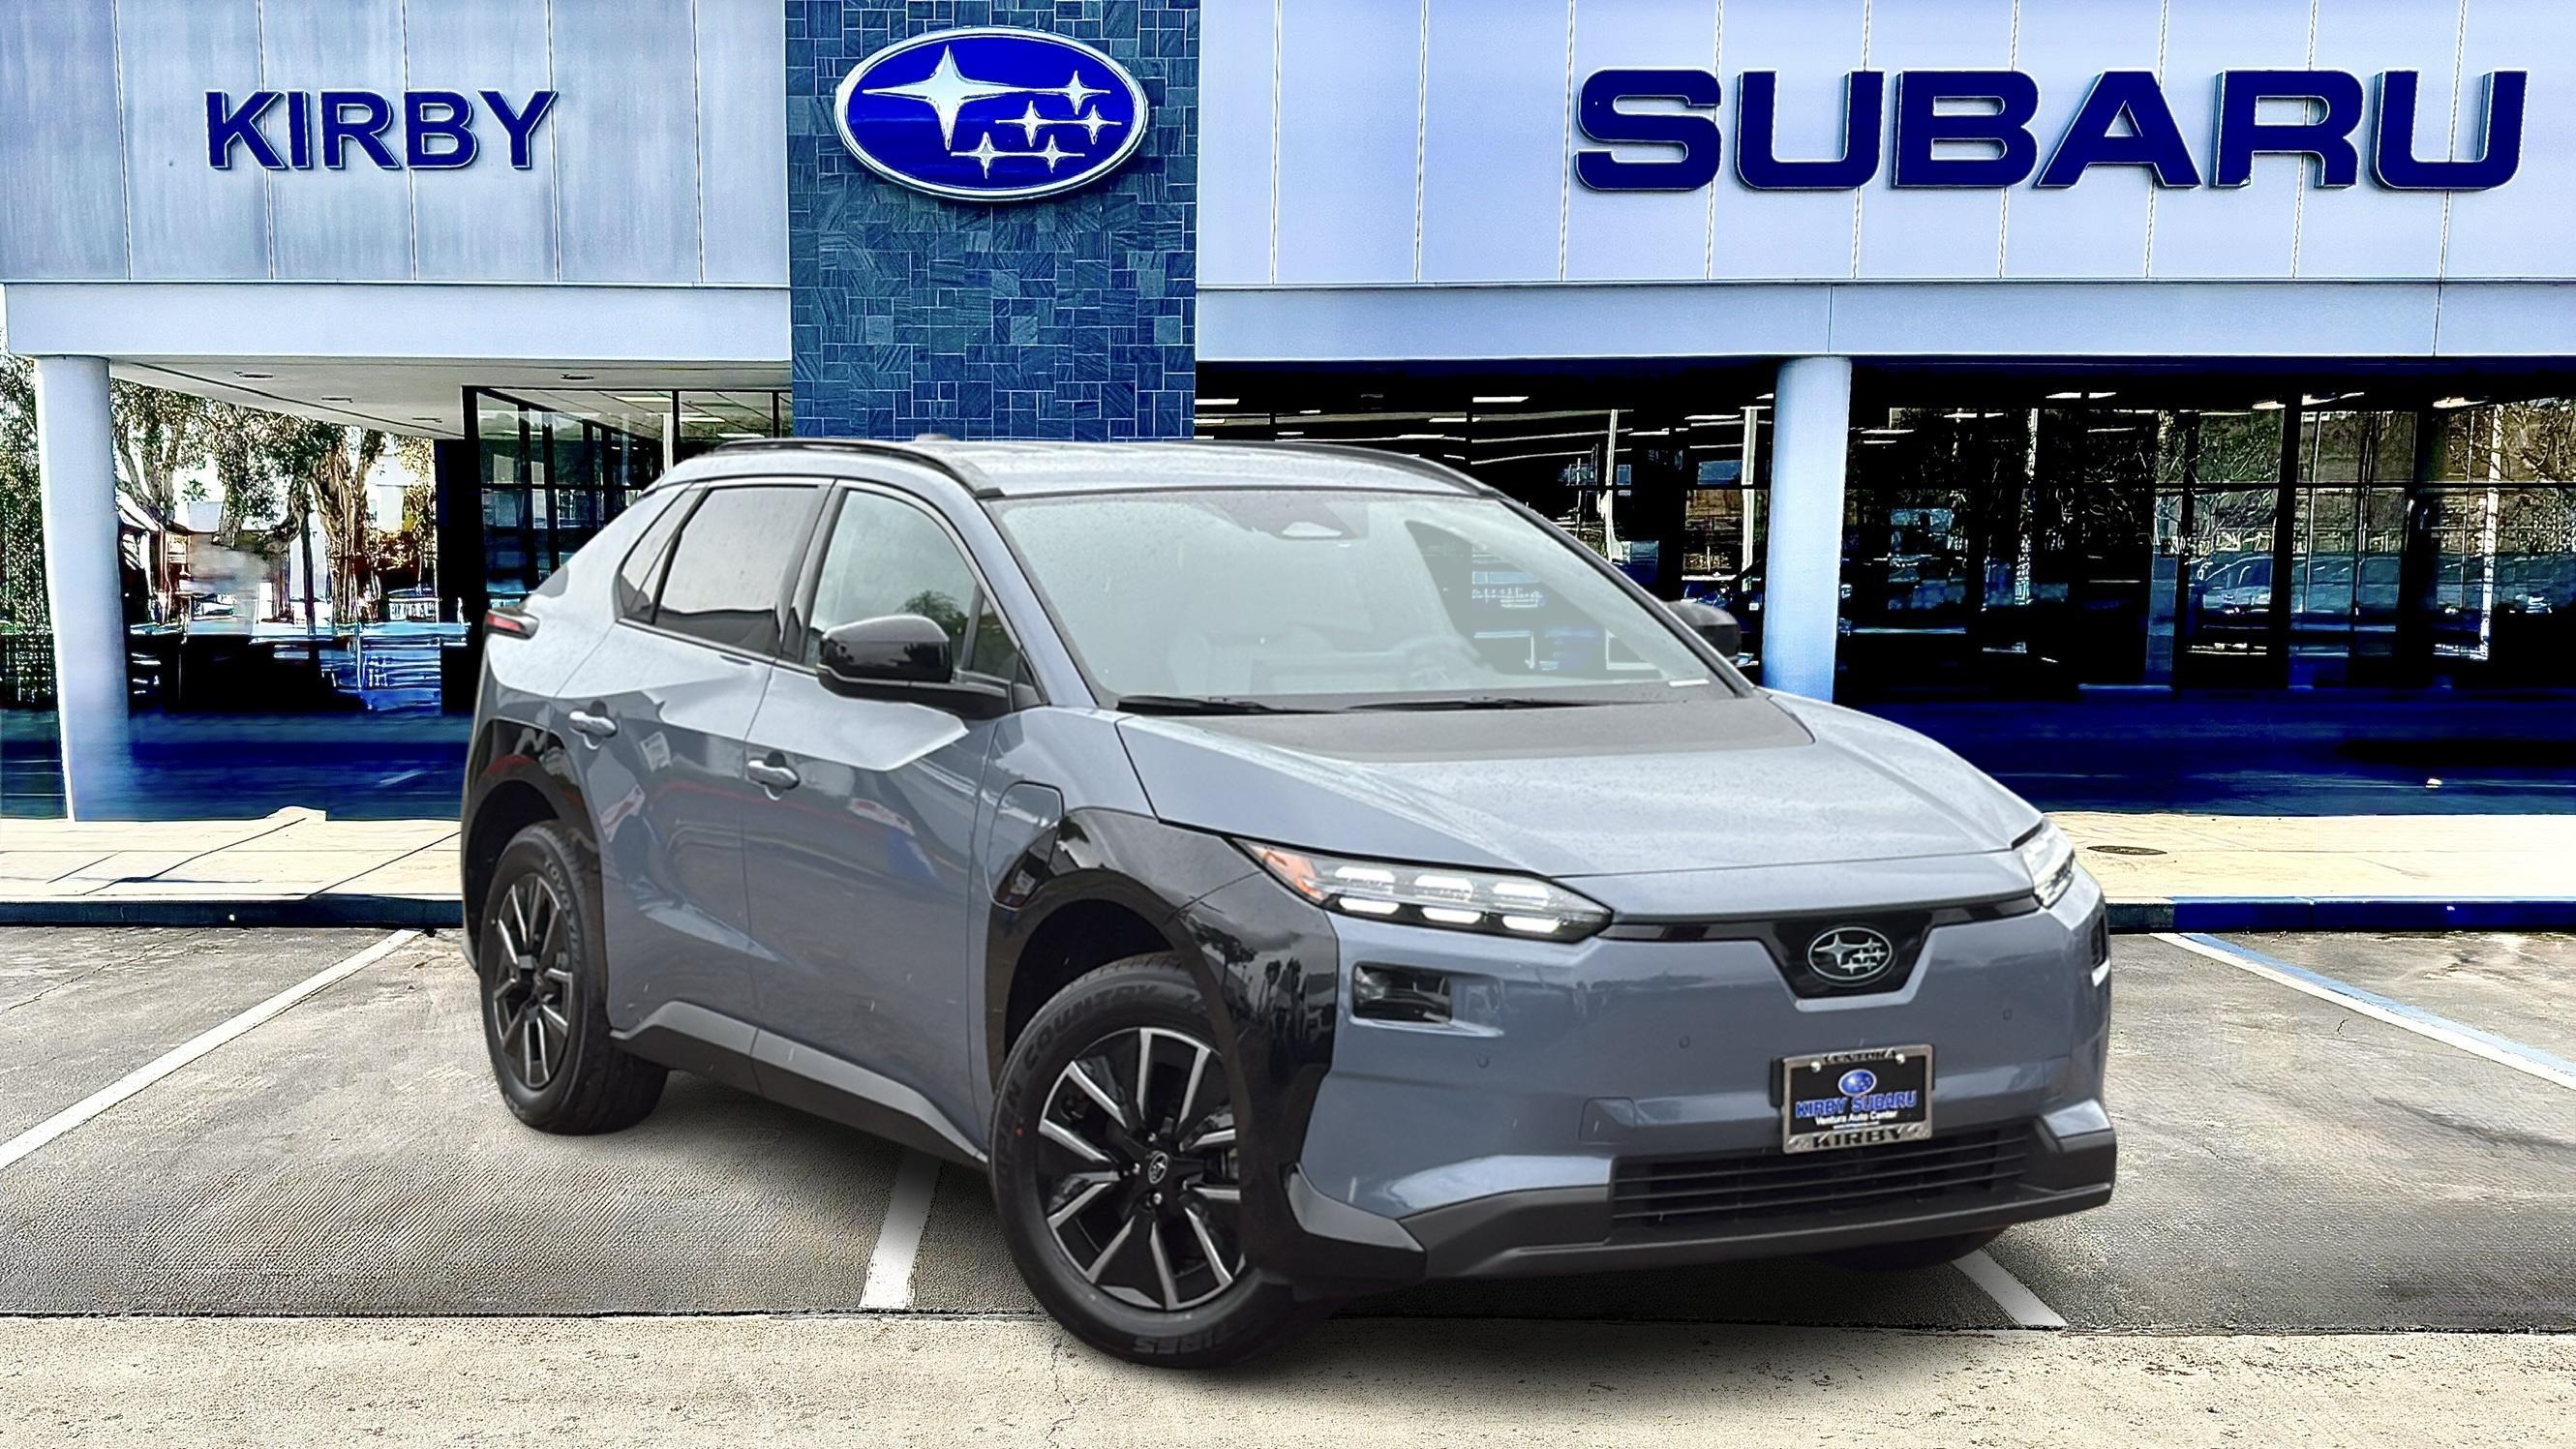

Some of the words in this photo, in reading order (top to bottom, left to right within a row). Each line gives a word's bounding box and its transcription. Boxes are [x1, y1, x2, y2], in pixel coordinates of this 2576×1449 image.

[205, 90, 559, 170] KIRBY
[1575, 68, 2528, 192] SUBARU
[544, 859, 571, 912] TOYO
[1023, 983, 1158, 1072] COUNTRY
[1797, 1098, 1847, 1118] KIRBY
[1853, 1091, 1916, 1112] SUBARU
[1815, 1114, 1846, 1126] Ventura
[1849, 1112, 1868, 1122] Auto
[1870, 1110, 1897, 1120] Center
[1813, 1128, 1902, 1148] KIRBY
